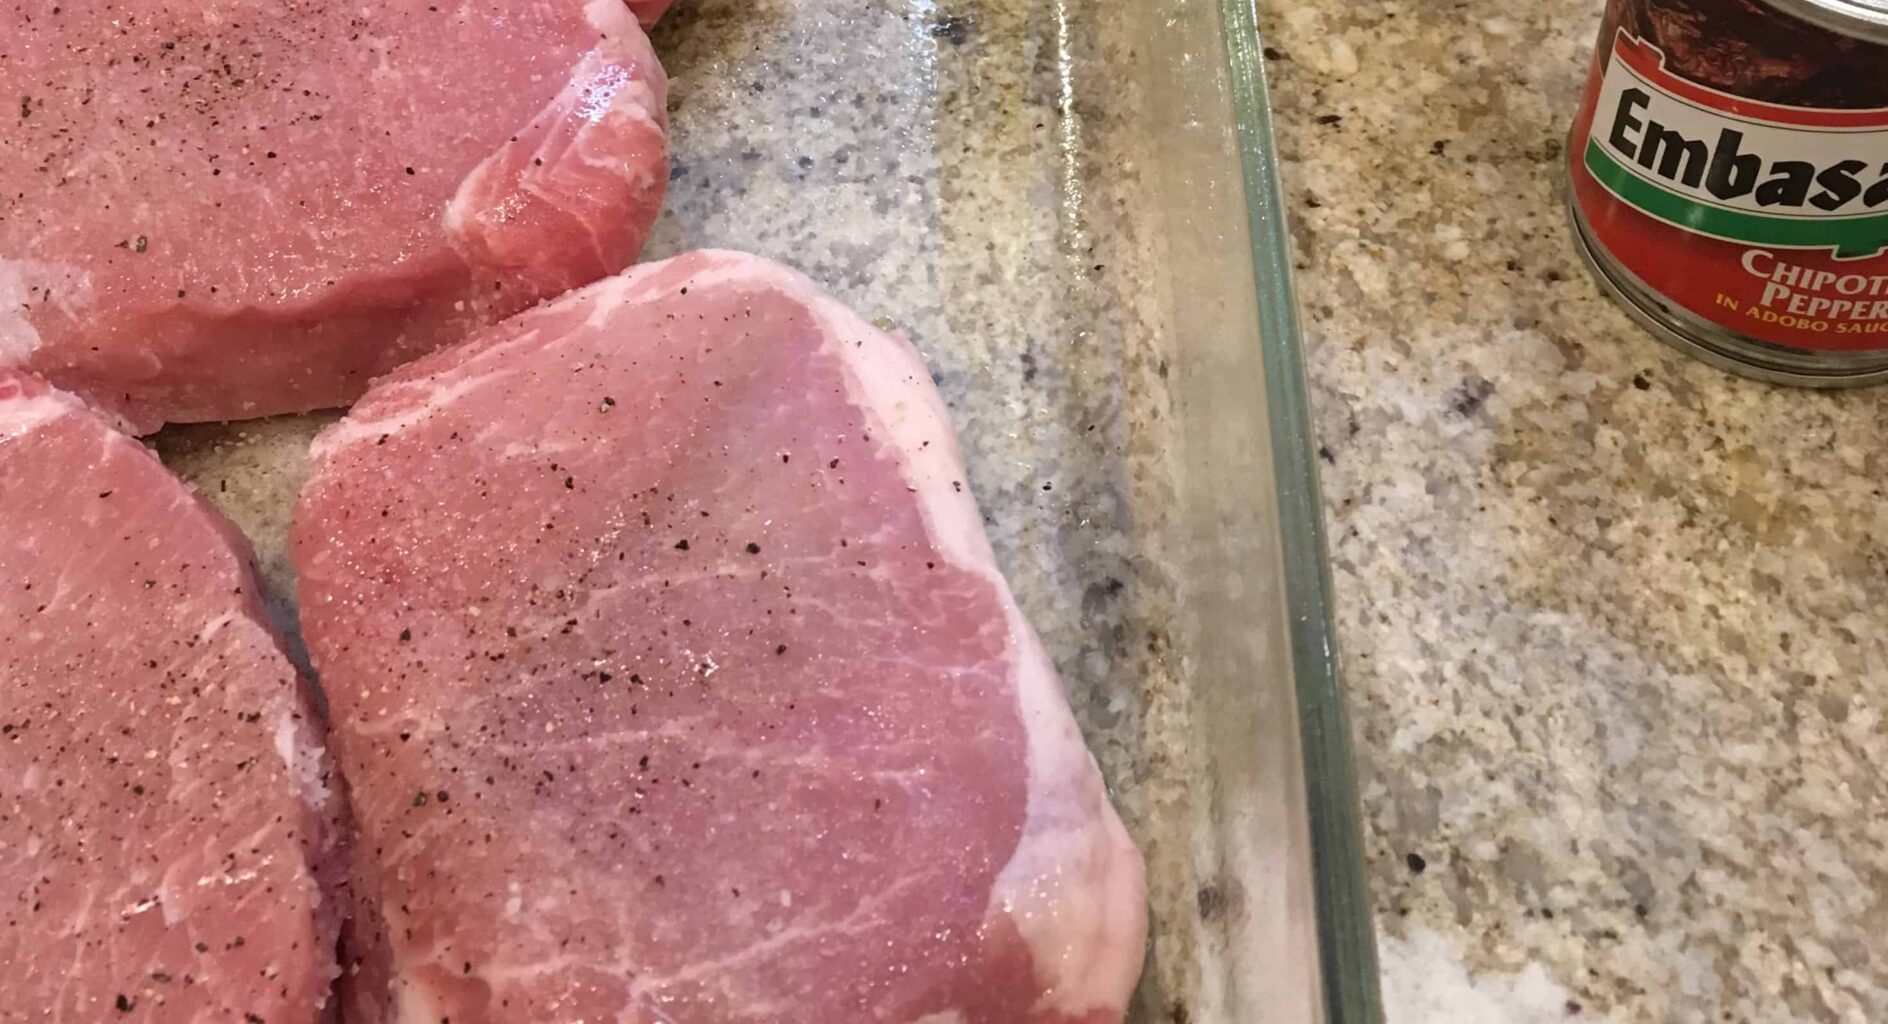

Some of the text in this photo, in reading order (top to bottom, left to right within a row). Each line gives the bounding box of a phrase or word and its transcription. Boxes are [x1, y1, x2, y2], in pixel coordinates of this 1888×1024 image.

[1741, 249, 1888, 296] CHIPOT
[1715, 293, 1740, 311] IN
[1745, 306, 1829, 332] ADOBO
